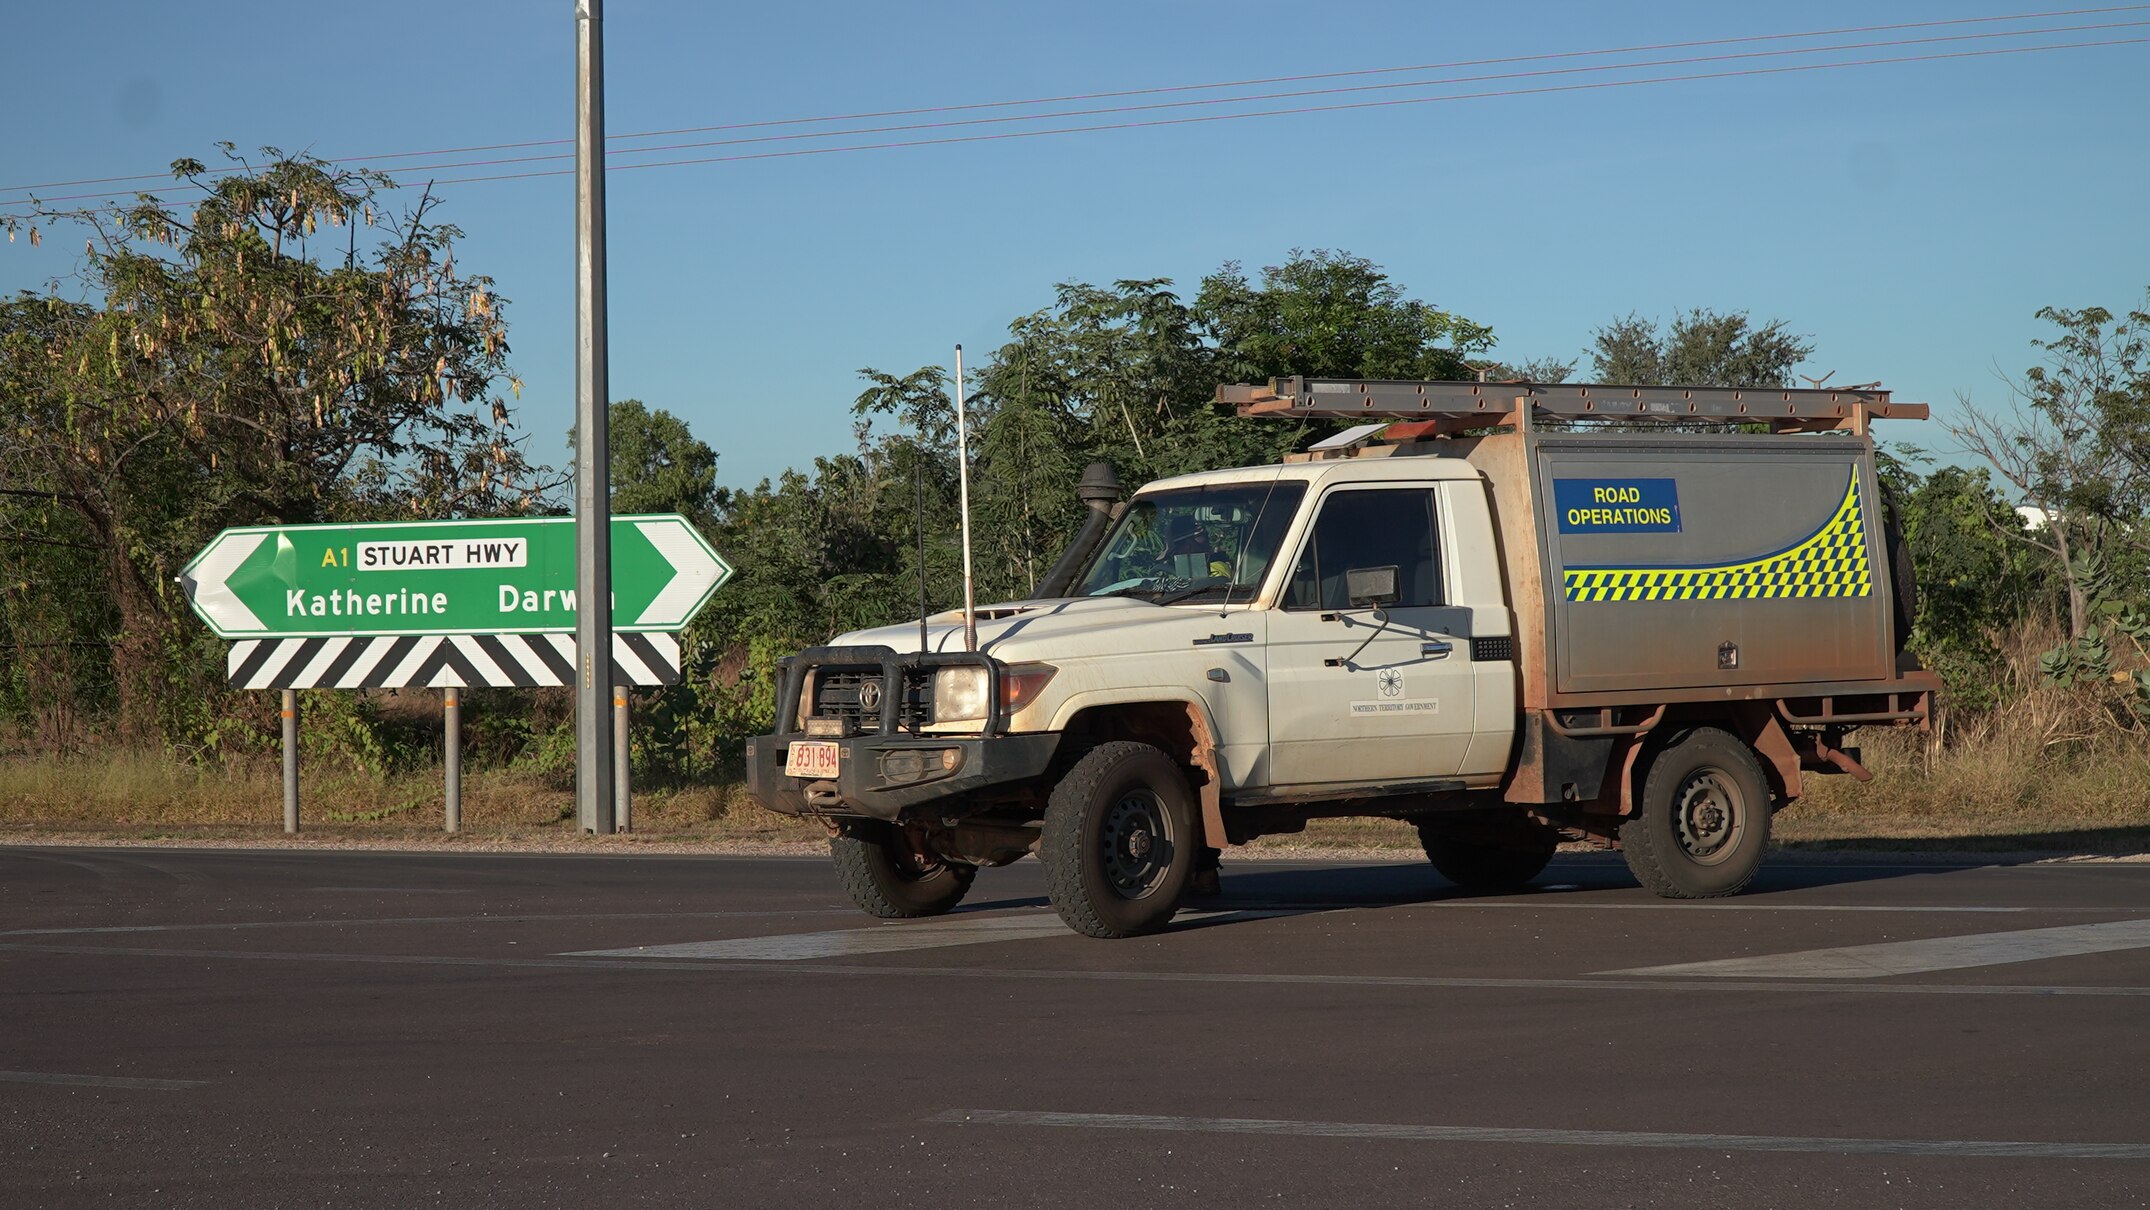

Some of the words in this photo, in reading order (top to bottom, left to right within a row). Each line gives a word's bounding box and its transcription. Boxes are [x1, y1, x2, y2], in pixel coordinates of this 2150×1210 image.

[1593, 487, 1641, 503] ROAD
[1567, 508, 1672, 525] OPERATIONS
[321, 547, 348, 567] A1
[364, 544, 454, 566] STUART
[466, 543, 519, 563] HWY
[286, 587, 448, 616] Katherine
[498, 584, 615, 612] Darw
